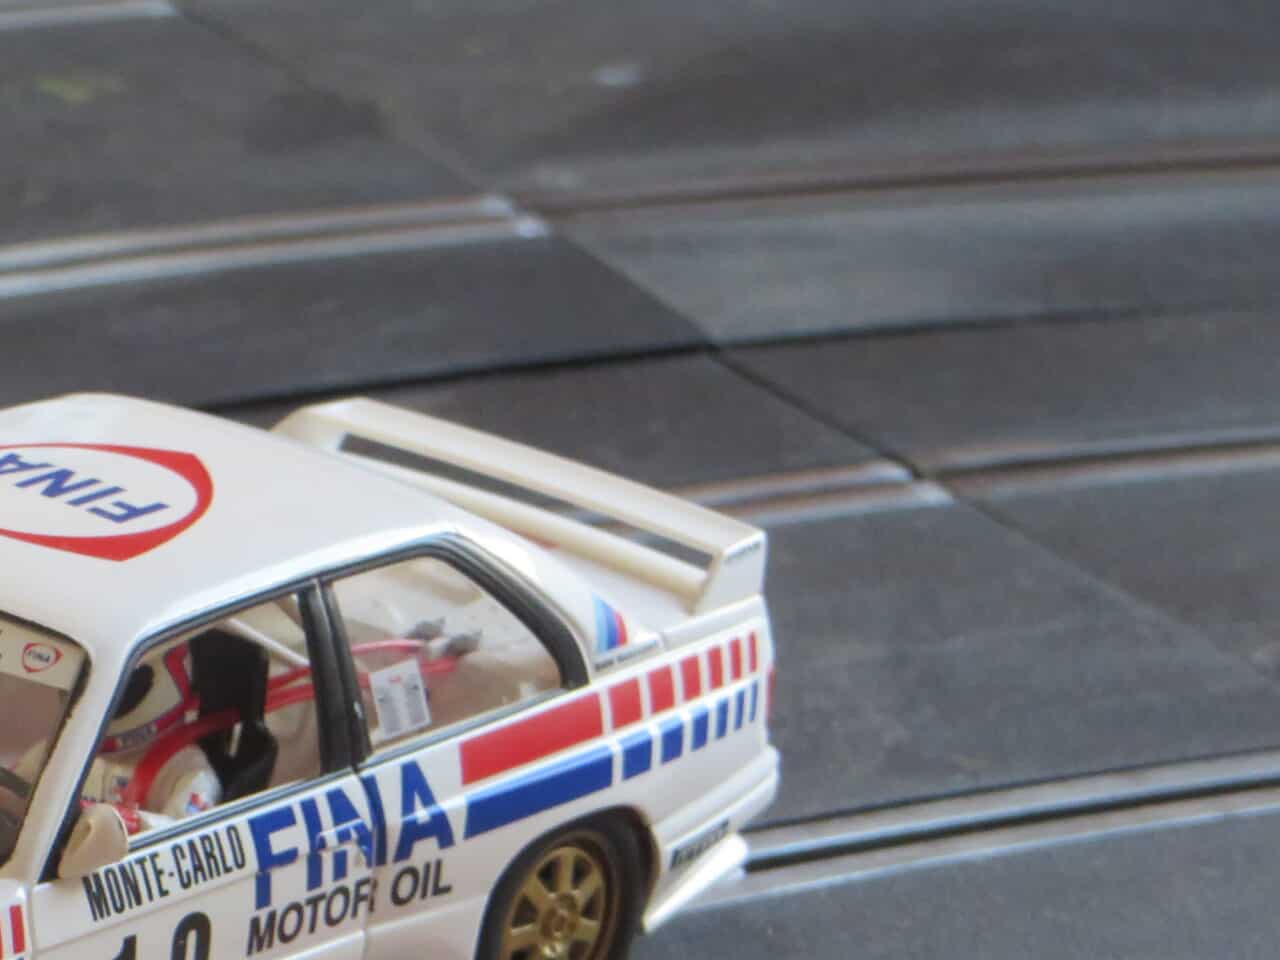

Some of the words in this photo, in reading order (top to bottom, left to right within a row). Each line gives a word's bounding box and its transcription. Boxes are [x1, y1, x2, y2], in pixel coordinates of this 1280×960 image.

[81, 824, 246, 922] MONTE-CARLO
[247, 761, 455, 911] FINA
[246, 877, 380, 956] MOTOR
[391, 859, 452, 906] OIL
